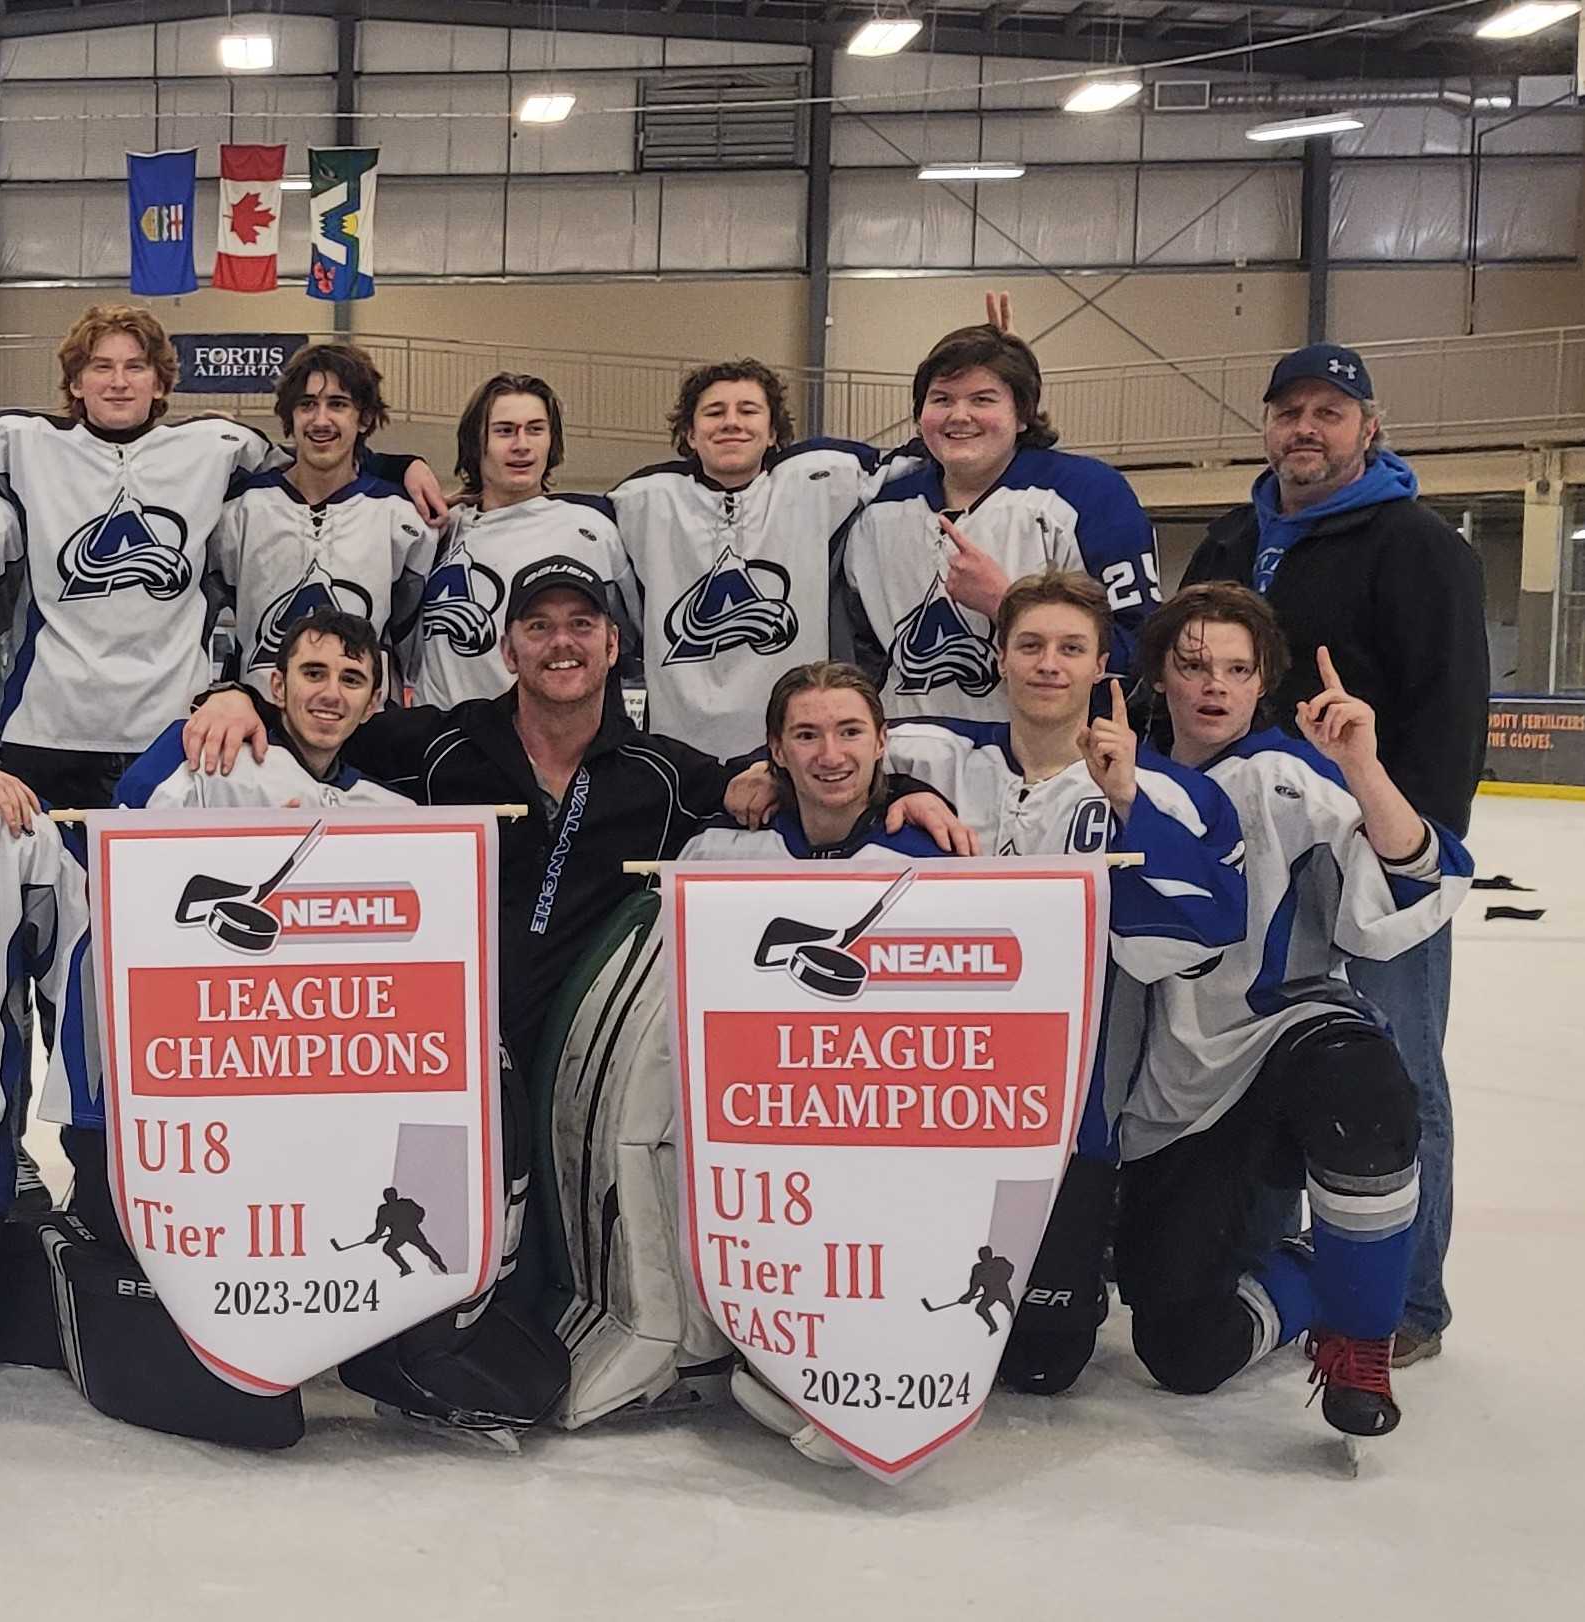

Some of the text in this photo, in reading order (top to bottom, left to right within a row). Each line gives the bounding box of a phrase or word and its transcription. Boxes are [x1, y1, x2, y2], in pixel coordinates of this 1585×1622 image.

[194, 347, 284, 365] FORTIS
[194, 364, 284, 377] ALBERTA
[530, 766, 591, 935] AVALANCHE
[1073, 801, 1107, 852] C
[281, 895, 408, 928] NEAHL
[869, 943, 1008, 974] NEAHL
[196, 974, 396, 1022] LEAGUE
[145, 1031, 450, 1080] CHAMPIONS
[776, 1023, 995, 1071] LEAGUE
[721, 1083, 1049, 1131] CHAMPIONS
[134, 1118, 231, 1175] U18
[710, 1165, 814, 1227] U18
[133, 1196, 226, 1258] Tier
[246, 1203, 307, 1258] III
[707, 1232, 886, 1300] Tier III
[214, 1279, 381, 1316] 2023-2024
[720, 1300, 826, 1359] EAST
[801, 1367, 971, 1410] 2023-2024
